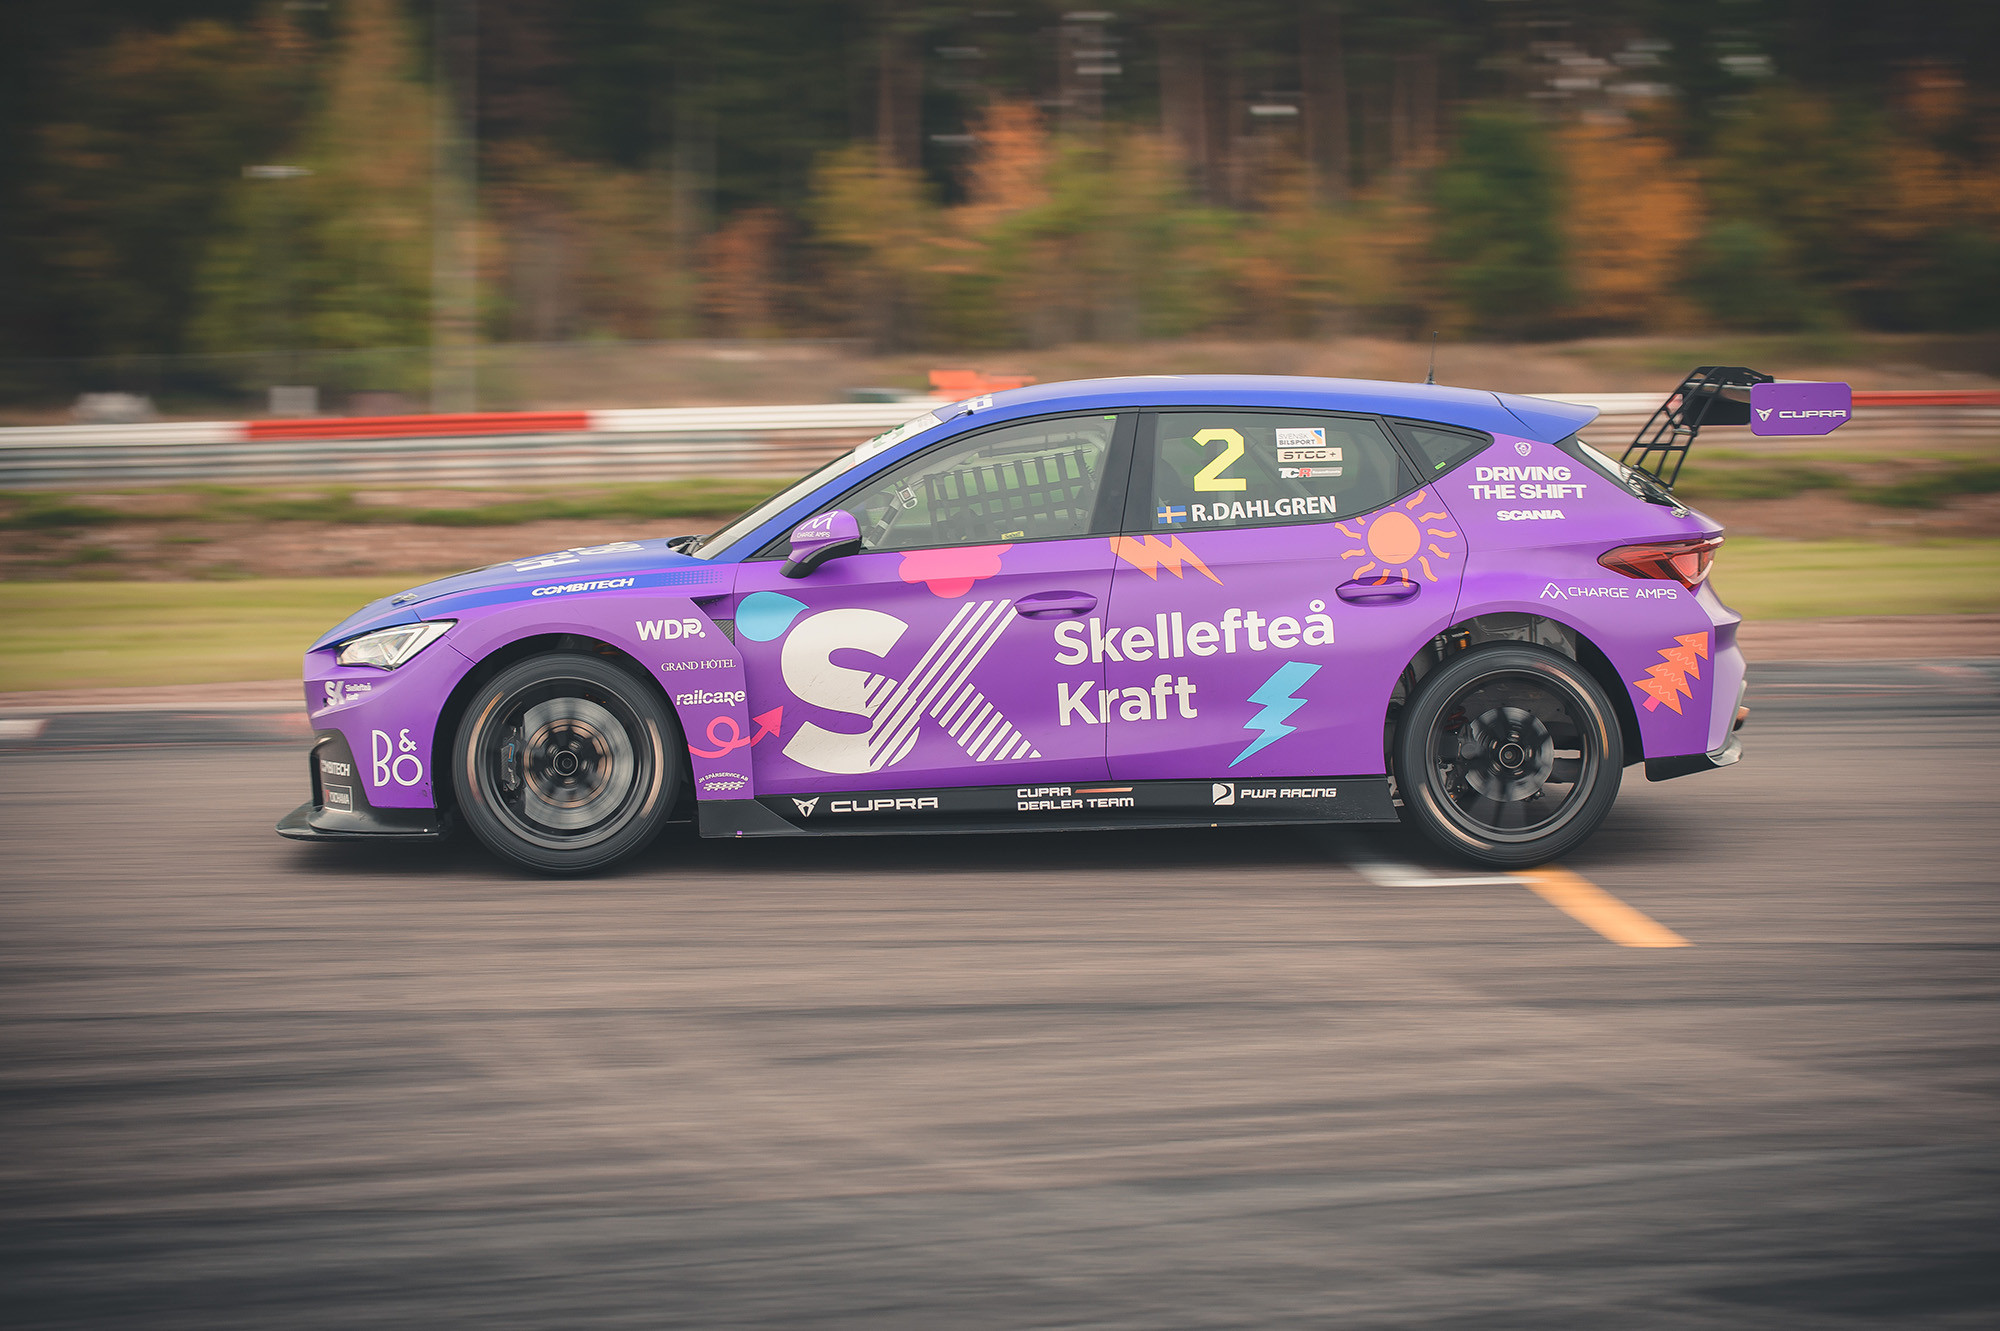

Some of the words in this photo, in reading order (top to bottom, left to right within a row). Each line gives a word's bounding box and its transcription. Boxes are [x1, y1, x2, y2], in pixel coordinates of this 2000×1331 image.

[1779, 410, 1847, 419] CUPRA
[1192, 428, 1247, 492] 2
[1278, 467, 1312, 479] TCR
[1475, 466, 1572, 482] DRIVING
[1467, 484, 1517, 500] THE
[1519, 483, 1588, 500] SHIFT
[1191, 495, 1338, 523] R.DAHLGREN
[1496, 509, 1566, 521] SCANIA
[796, 530, 815, 539] CHARGE
[531, 577, 635, 597] COMBITECH
[1567, 586, 1630, 599] CHARGE
[1635, 588, 1678, 600] AMPS
[1054, 599, 1335, 666] Skellefteå
[660, 661, 699, 672] GRAND
[700, 658, 737, 670] HÔTEL
[780, 599, 1042, 775] SK
[676, 689, 746, 707] railcare
[1058, 674, 1198, 727] Kraft
[1016, 786, 1072, 798] CUPRA
[1240, 788, 1277, 799] PWR
[1279, 787, 1337, 798] RACING
[830, 796, 939, 813] CUPRA
[1017, 799, 1084, 811] DEALER
[1086, 797, 1135, 809] TEAM
